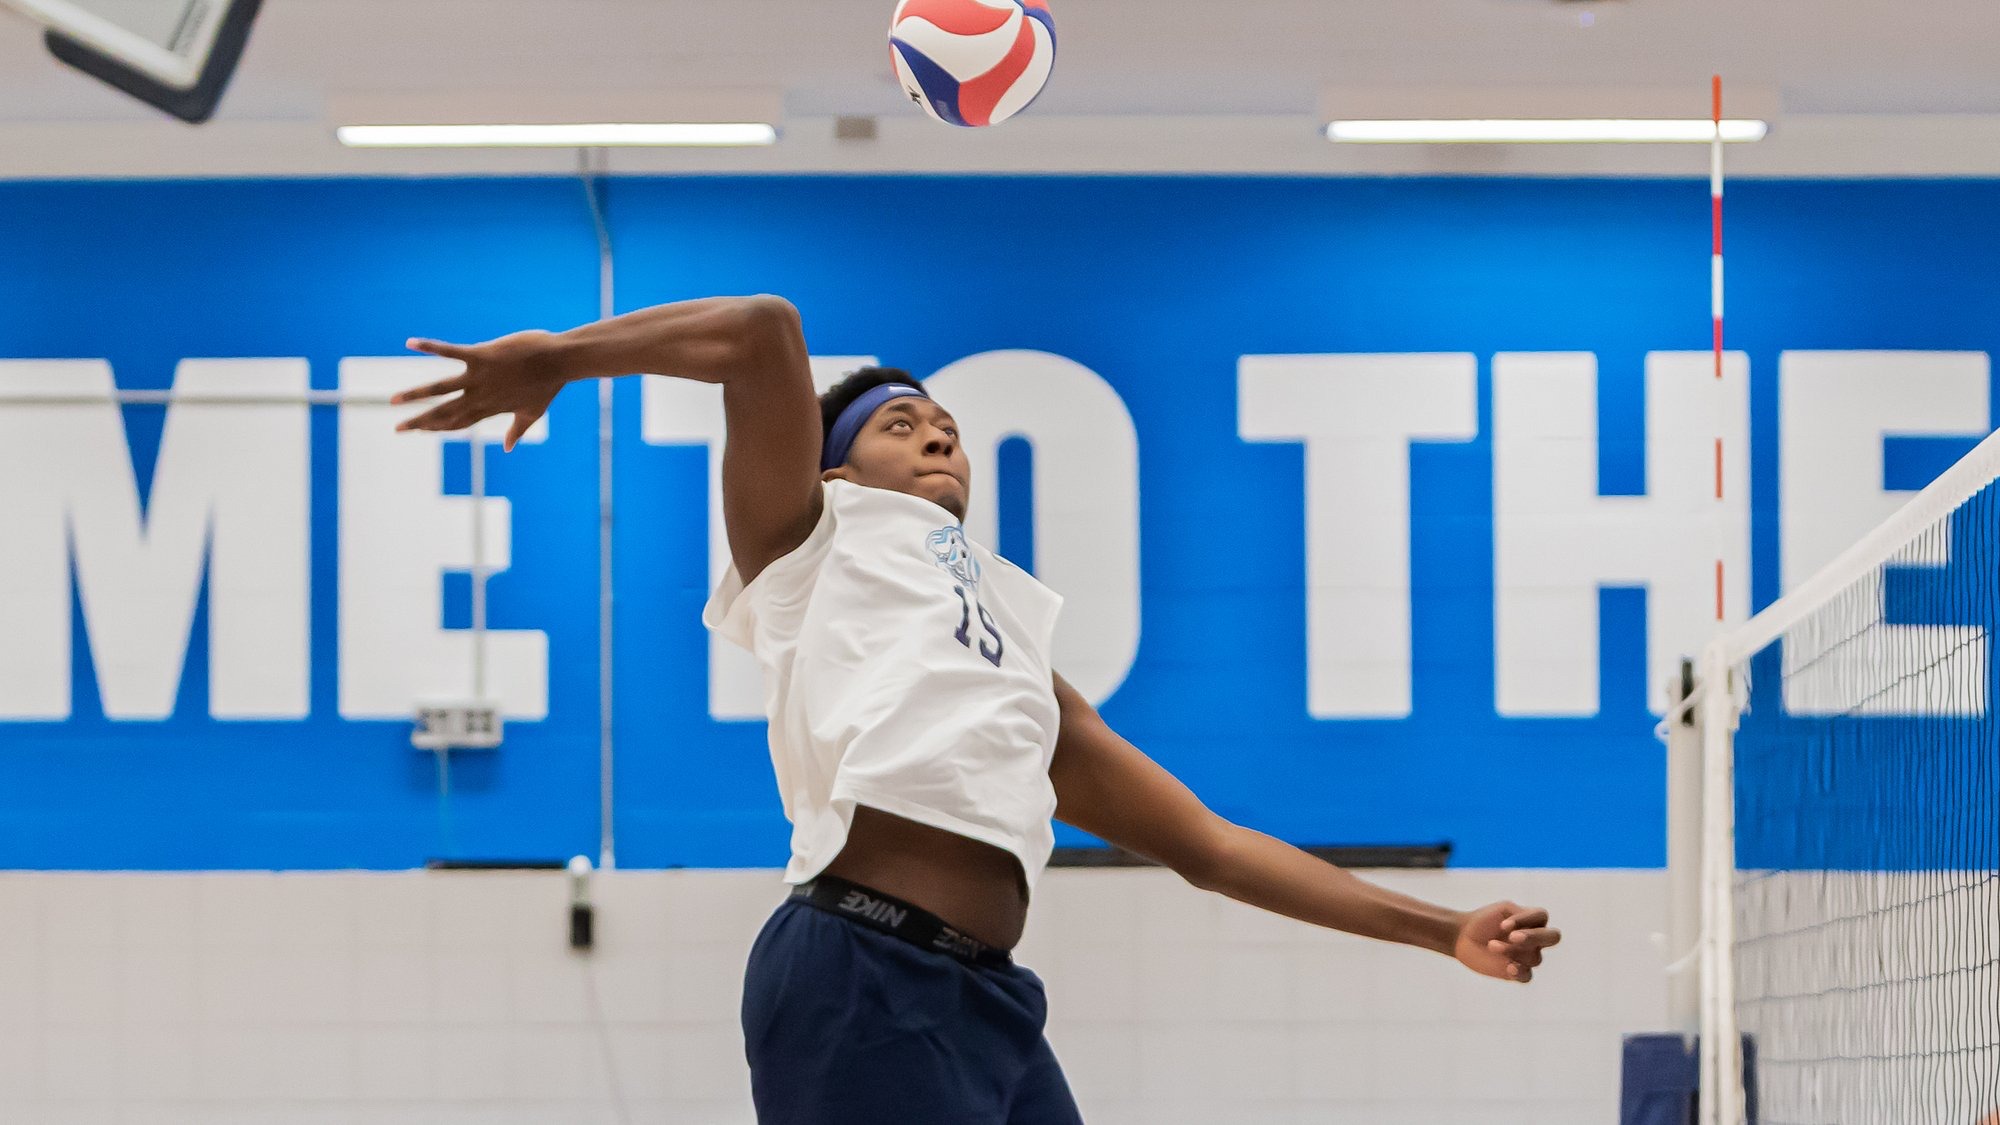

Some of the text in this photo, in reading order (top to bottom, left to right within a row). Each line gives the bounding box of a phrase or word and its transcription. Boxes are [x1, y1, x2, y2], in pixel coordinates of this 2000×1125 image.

[0, 356, 549, 721] ME
[1236, 349, 1991, 719] THE
[953, 584, 1004, 669] 15
[837, 890, 909, 928] NIKE
